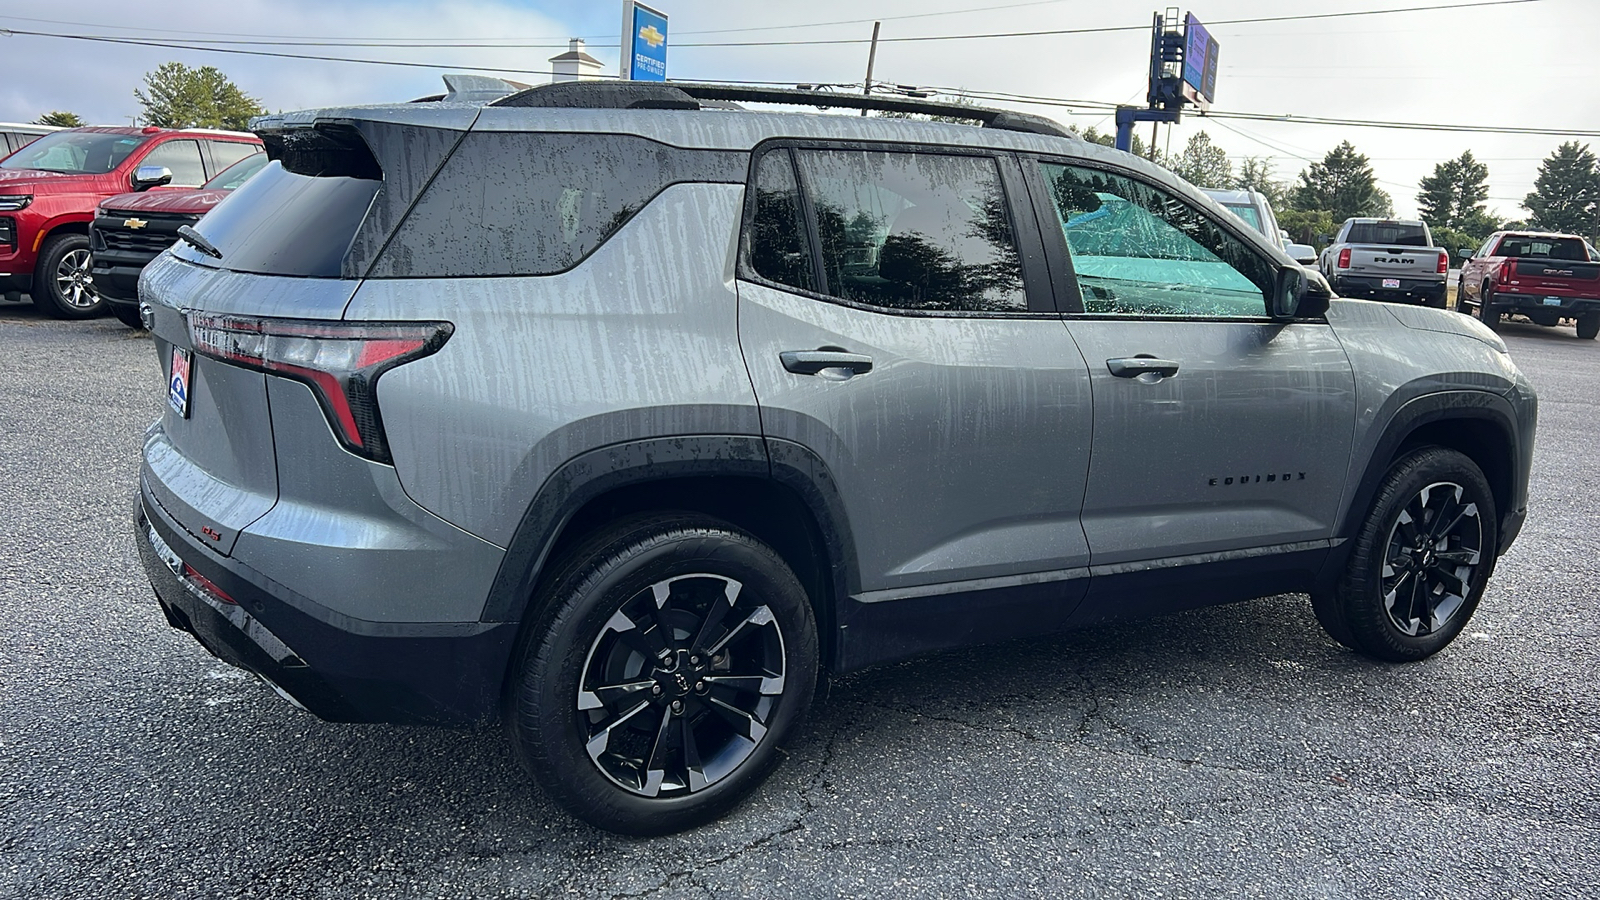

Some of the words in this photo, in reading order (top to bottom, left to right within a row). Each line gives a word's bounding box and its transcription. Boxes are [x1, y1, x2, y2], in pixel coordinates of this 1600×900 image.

[636, 53, 665, 69] CERTIFIED
[637, 62, 664, 76] PRE-OWNED
[1374, 256, 1415, 264] RAM
[1208, 471, 1307, 486] EQUINOX
[201, 525, 219, 541] RS
